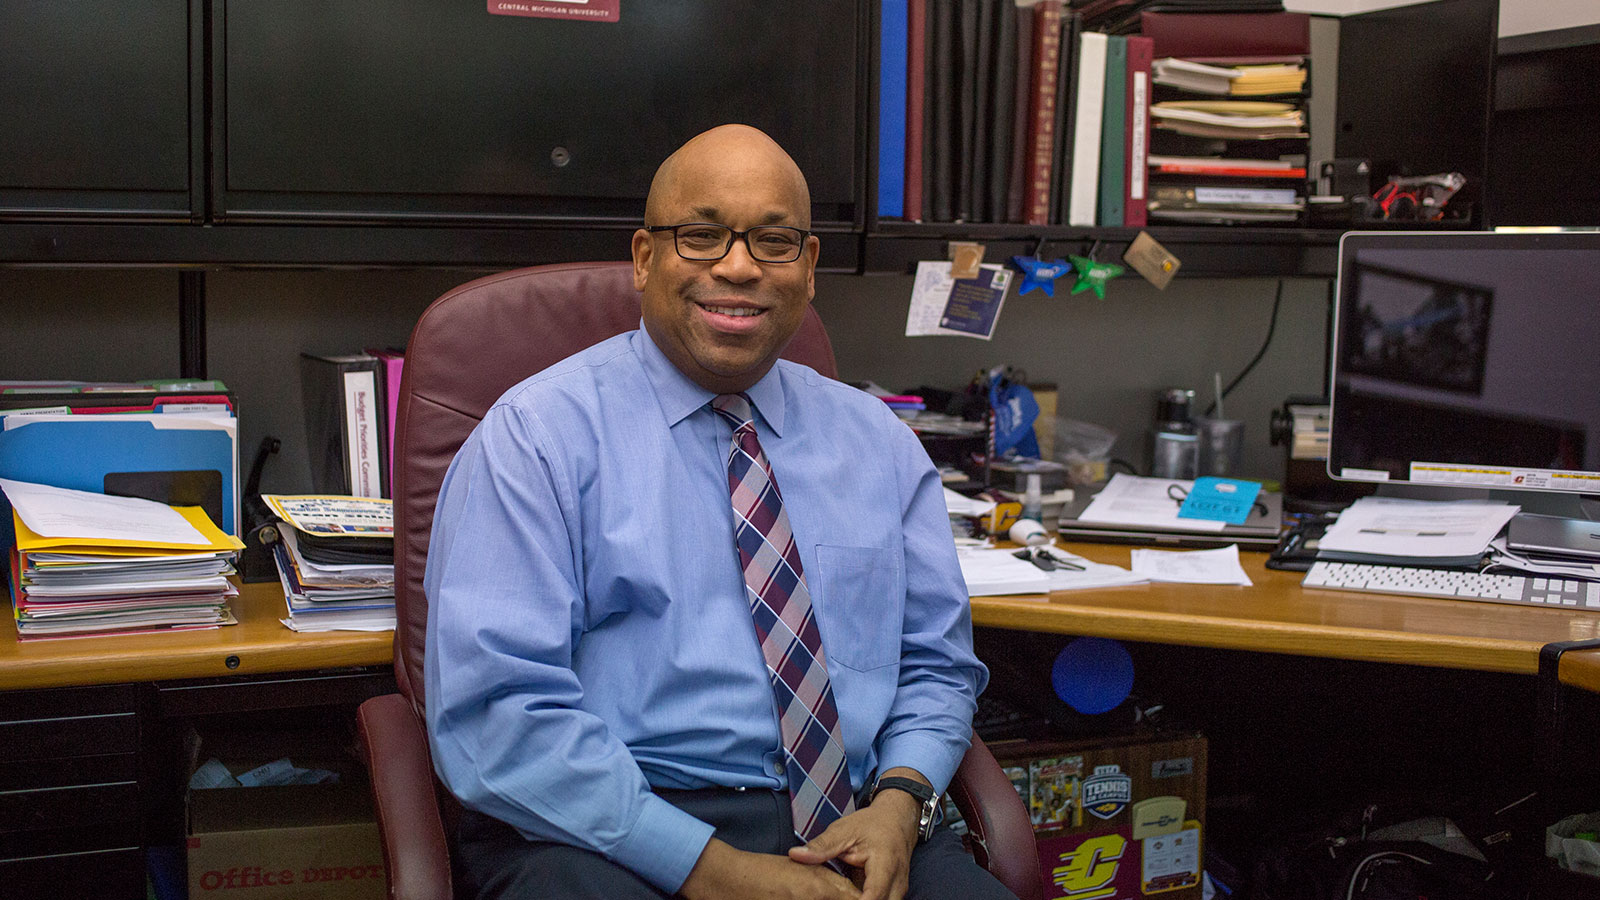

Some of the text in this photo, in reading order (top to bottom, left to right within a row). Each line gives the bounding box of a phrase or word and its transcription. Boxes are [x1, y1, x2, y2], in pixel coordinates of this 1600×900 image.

[498, 3, 609, 17] CENTRAL MICHIGAN UNIVERSITY
[357, 391, 367, 421] Budget
[360, 423, 369, 460] Priorities
[1086, 781, 1128, 796] TENNIS
[200, 864, 385, 891] Office DEPOT
